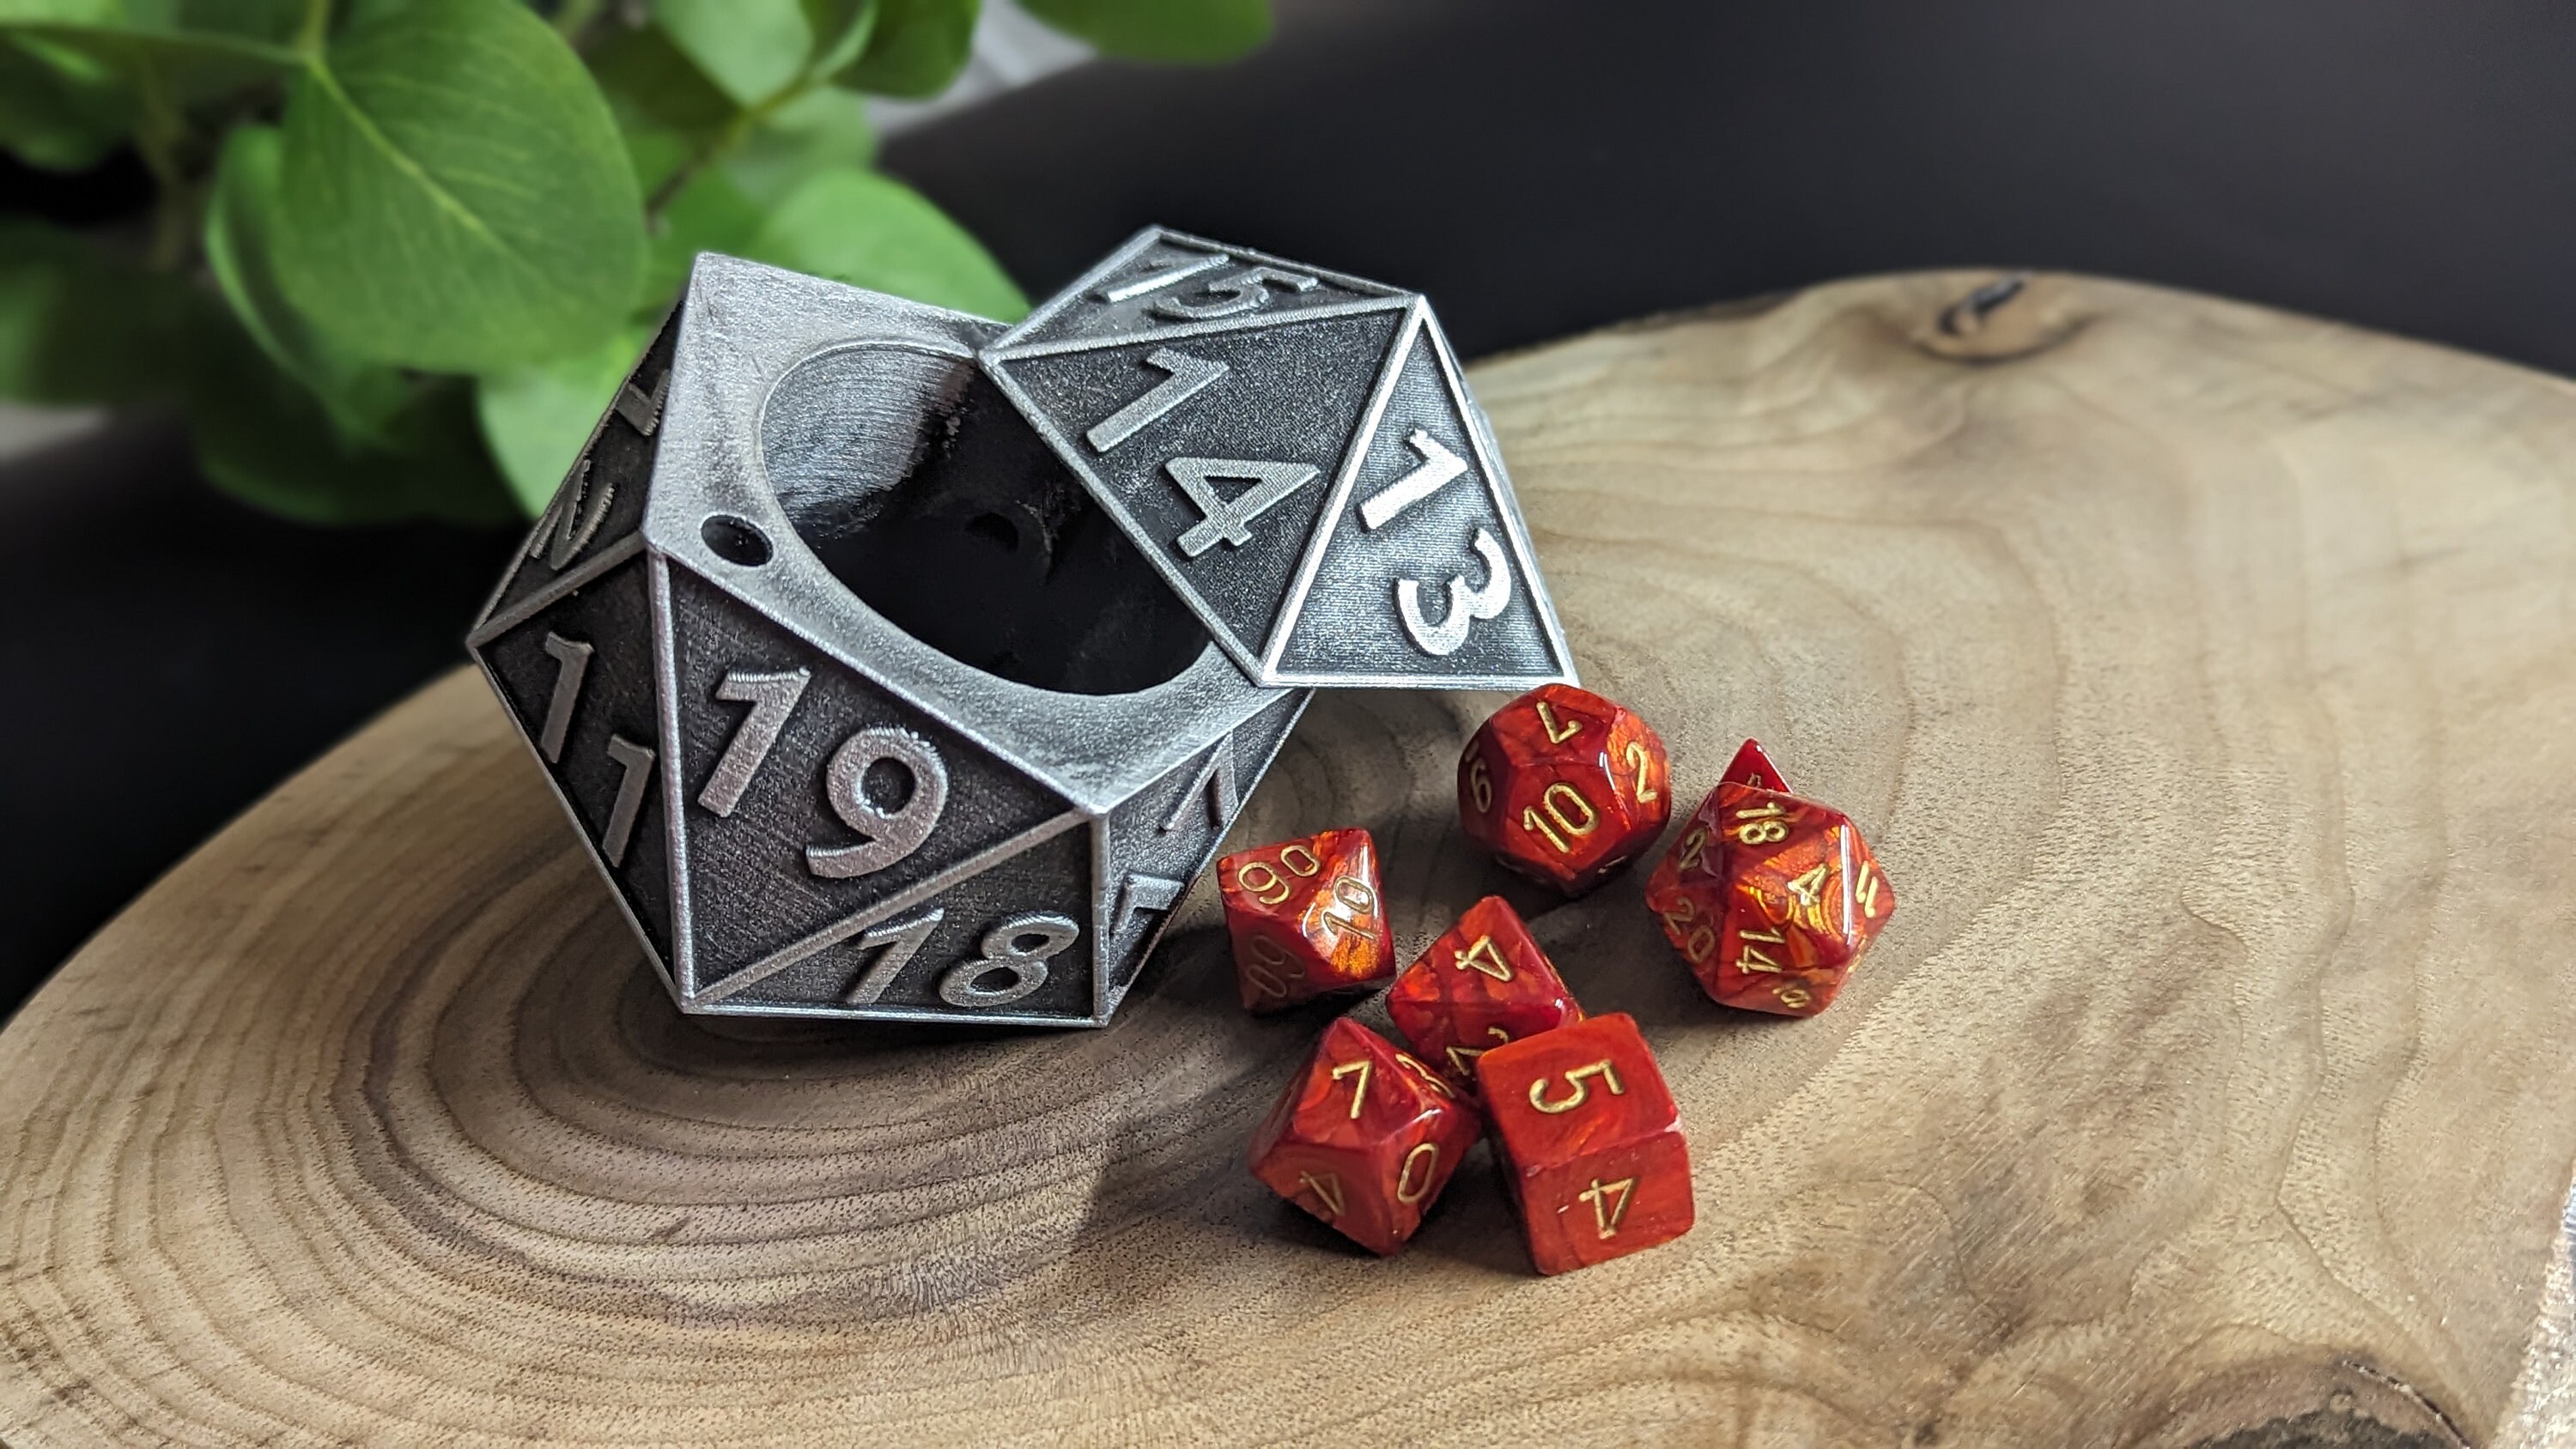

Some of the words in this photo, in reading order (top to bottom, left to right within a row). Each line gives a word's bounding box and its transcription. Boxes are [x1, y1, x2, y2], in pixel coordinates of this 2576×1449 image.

[1105, 253, 1319, 319] 15
[1086, 348, 1321, 559] 14
[1361, 428, 1512, 658] 13
[541, 631, 657, 868] 11
[1535, 700, 1582, 744] 7
[698, 667, 949, 879] 19
[1625, 742, 1657, 803] 2
[1523, 782, 1599, 854] 10
[1735, 801, 1789, 846] 18
[1237, 845, 1320, 905] 90
[1679, 827, 1707, 872] 2
[1320, 875, 1377, 941] 10
[1788, 863, 1828, 906] 4
[847, 907, 1080, 1007] 18
[1454, 934, 1514, 982] 4
[1662, 897, 1716, 963] 20
[1735, 927, 1786, 975] 14
[1332, 1059, 1373, 1119] 7
[1528, 1058, 1625, 1114] 5
[1578, 1177, 1640, 1240] 4
